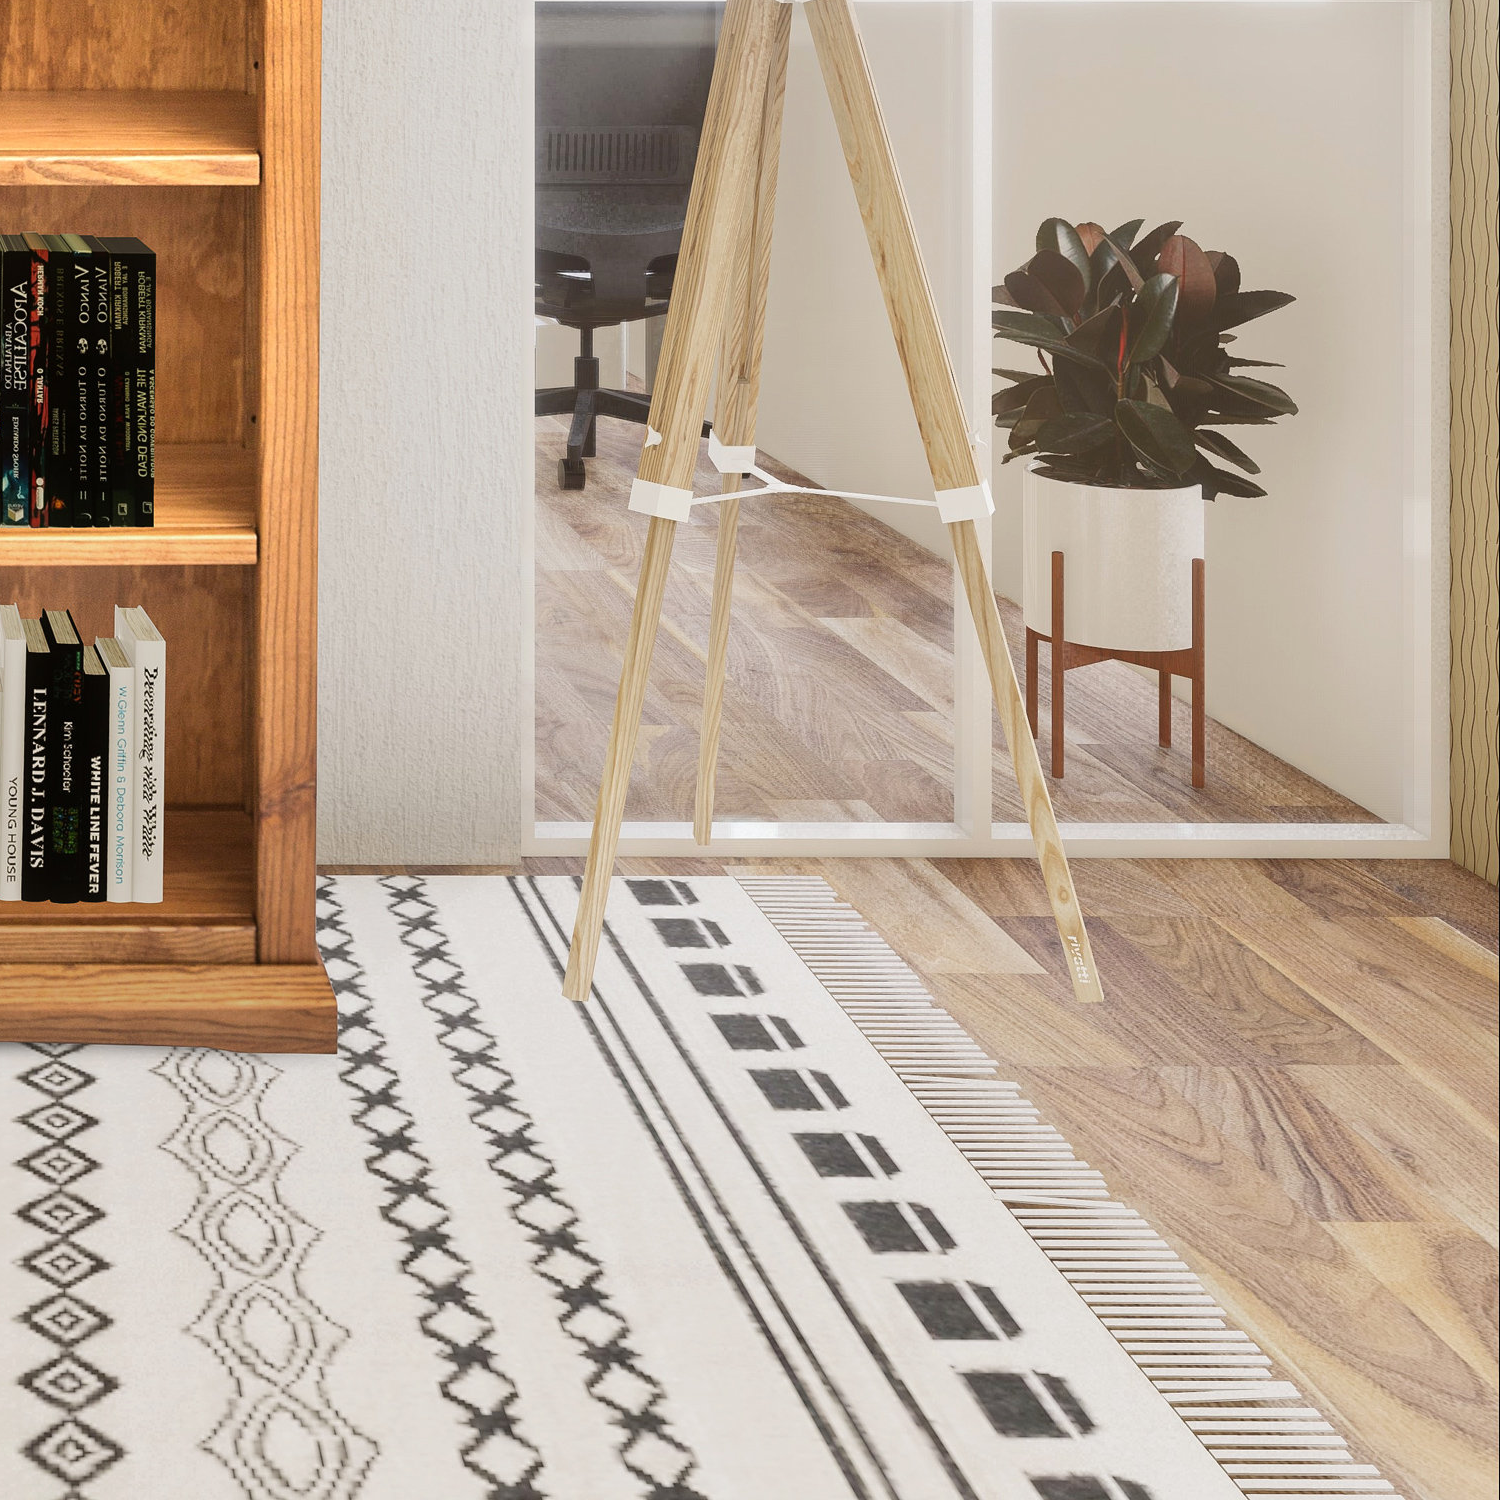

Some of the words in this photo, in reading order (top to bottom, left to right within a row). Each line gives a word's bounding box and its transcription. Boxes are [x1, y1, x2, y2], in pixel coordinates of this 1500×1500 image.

[31, 688, 47, 783] LENNARD
[116, 738, 127, 772] Griffin
[7, 778, 18, 830] YOUNG
[30, 787, 45, 802] J.
[90, 756, 101, 804] WHITE
[116, 776, 126, 784] &
[90, 807, 100, 841] LINE
[116, 787, 126, 832] Debora
[6, 833, 17, 882] HOUSE
[30, 808, 44, 868] DAVIS
[115, 836, 125, 885] Morrison
[88, 844, 100, 894] FEVER
